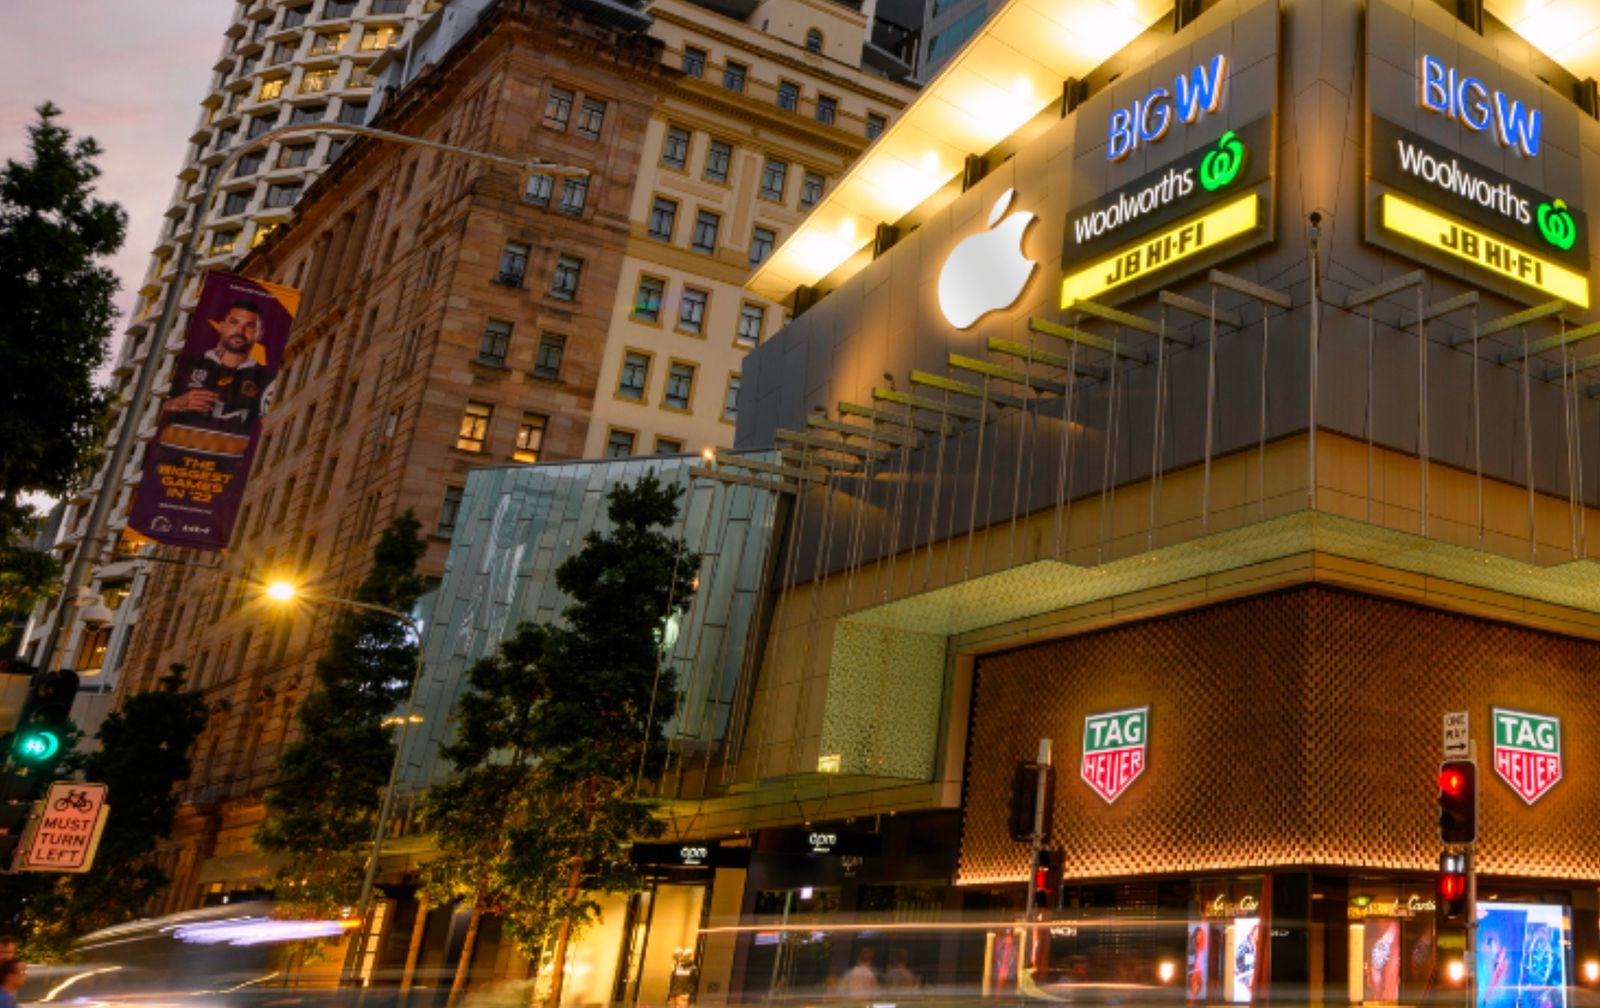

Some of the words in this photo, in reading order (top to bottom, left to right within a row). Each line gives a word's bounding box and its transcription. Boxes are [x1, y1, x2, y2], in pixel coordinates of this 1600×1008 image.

[1107, 88, 1171, 161] BIG
[1175, 54, 1228, 124] W
[1421, 54, 1491, 131] BIG
[1494, 91, 1542, 157] W
[1398, 140, 1531, 225] Woolworths
[1074, 168, 1194, 244] Woolworths
[1440, 225, 1480, 260] JB
[1106, 250, 1141, 286] JB
[158, 464, 234, 484] BIGGEST
[184, 456, 216, 471] THE
[162, 476, 223, 493] GAMES
[167, 487, 185, 499] IN
[1089, 715, 1141, 748] TAG
[1446, 728, 1466, 739] WAY
[1447, 715, 1465, 726] ONE
[1499, 717, 1554, 749] TAG
[1084, 751, 1141, 796] HEUER
[1498, 752, 1557, 797] HEUER
[41, 833, 86, 846] TURN
[44, 817, 91, 831] MUST
[36, 848, 80, 862] LEFT
